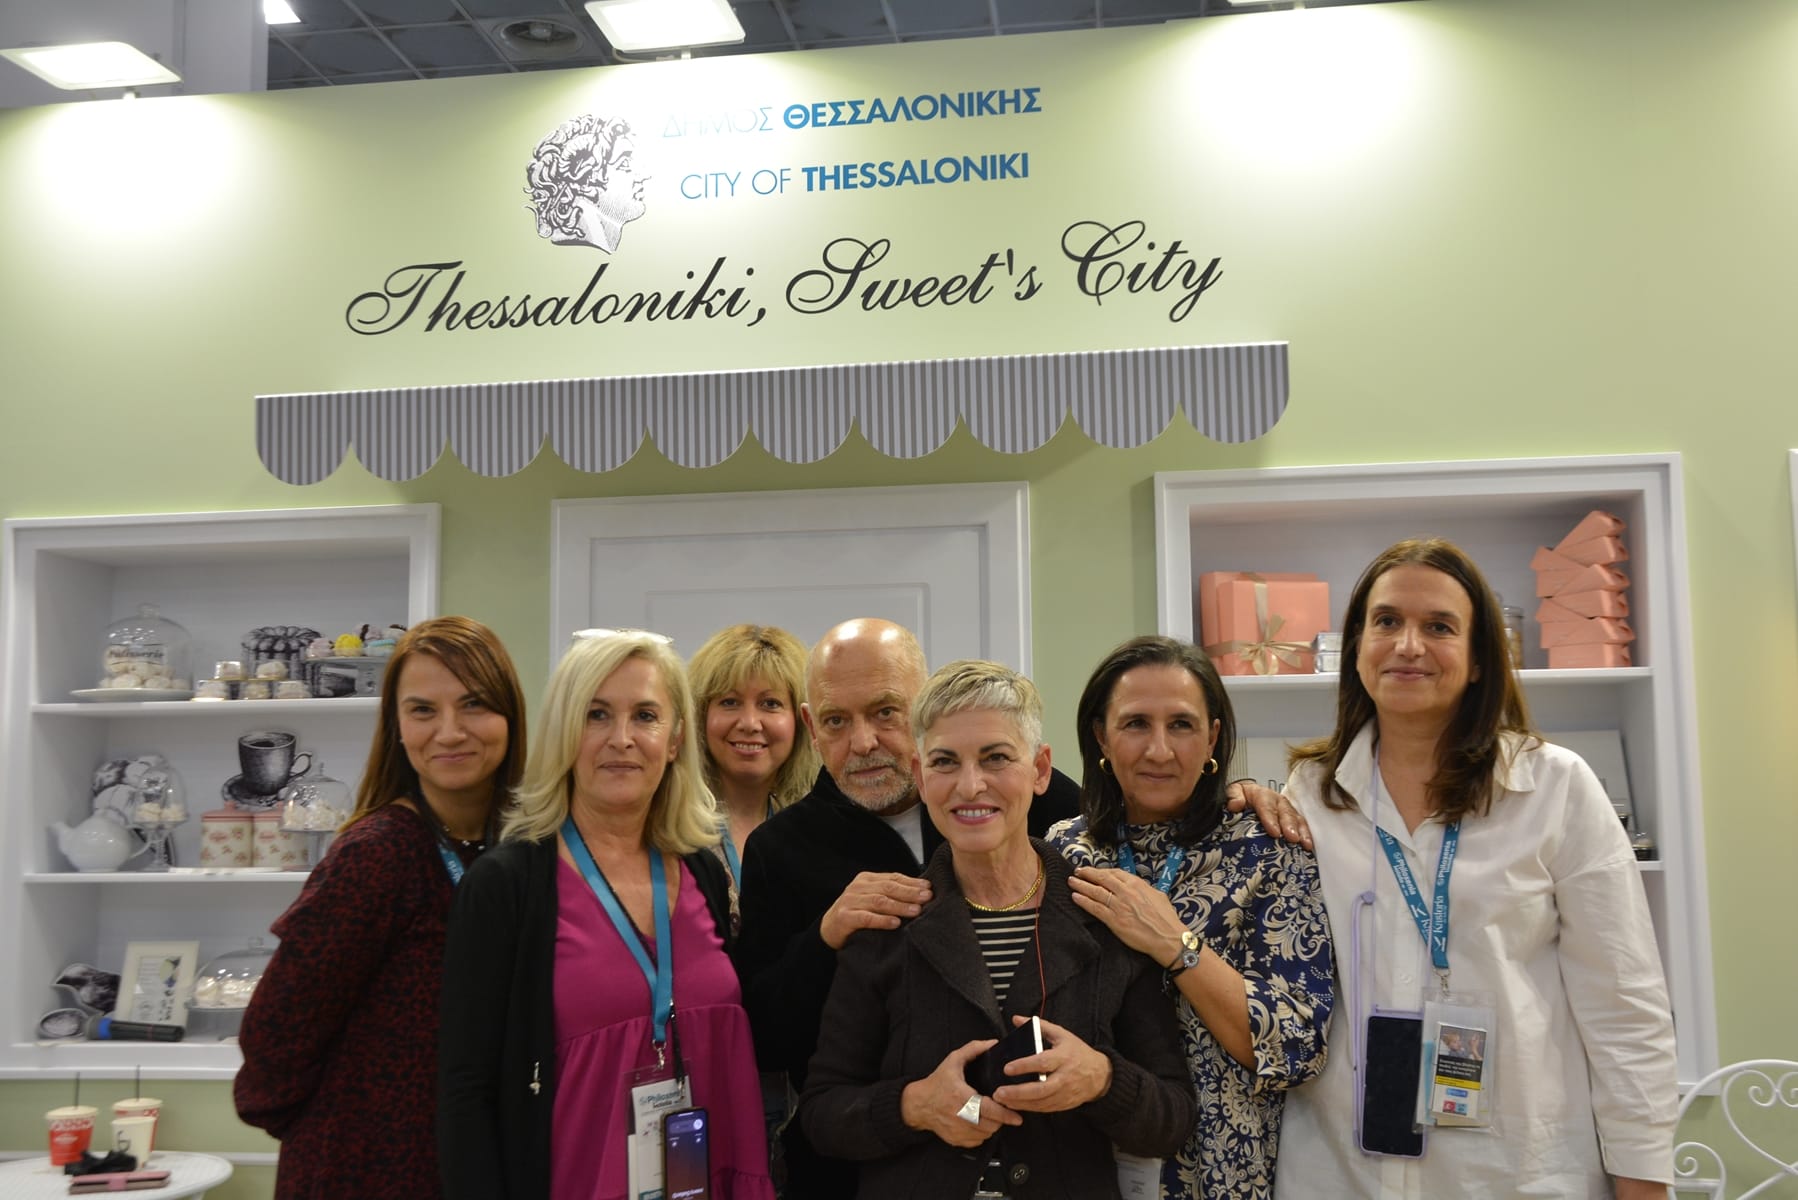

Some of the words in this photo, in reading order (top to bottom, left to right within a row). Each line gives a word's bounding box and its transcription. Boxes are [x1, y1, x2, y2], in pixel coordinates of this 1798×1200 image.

[783, 88, 1042, 131] ΘΕΣΣΑΛΟΝΙΚΗΣ
[680, 171, 742, 200] CITY
[752, 168, 791, 196] OF
[801, 153, 1029, 192] THESSALONIKI
[346, 256, 765, 335] Thessaloniki,
[786, 238, 1043, 314] Sweet's
[1061, 221, 1223, 322] City
